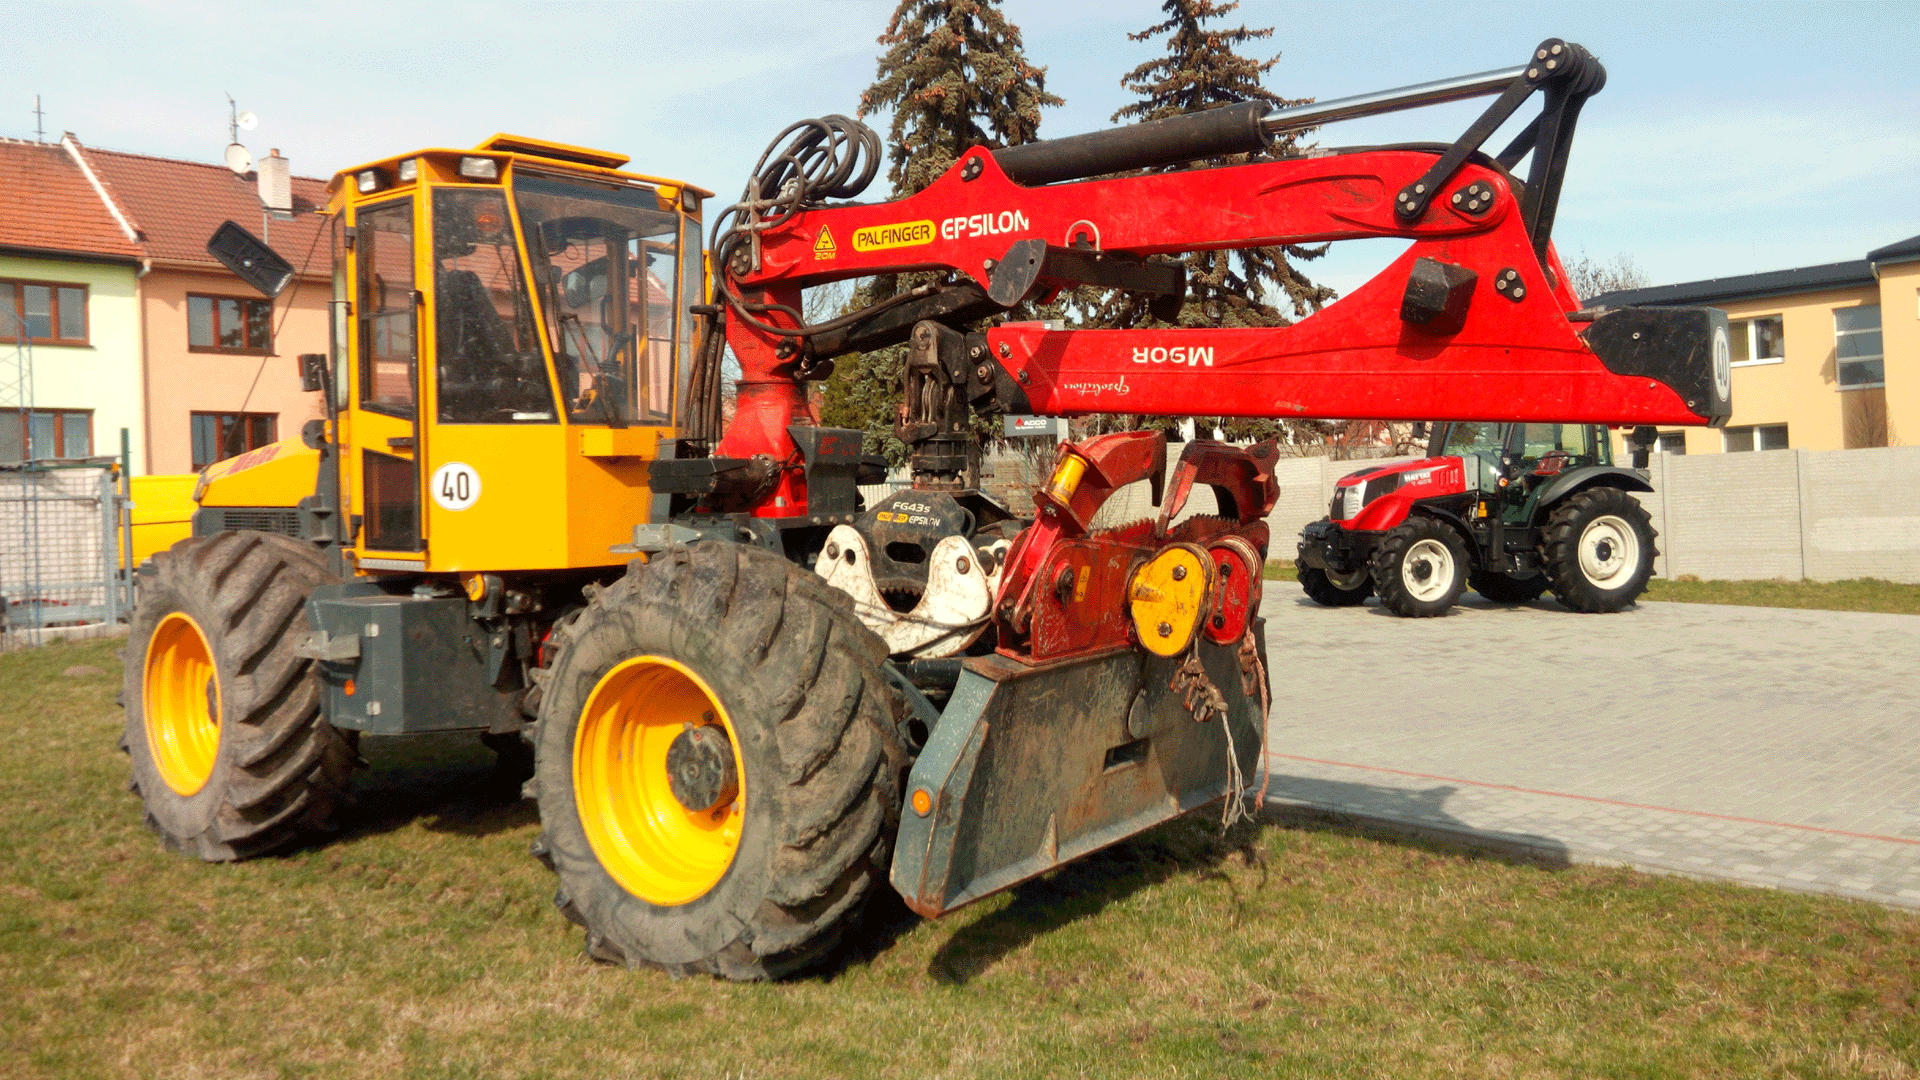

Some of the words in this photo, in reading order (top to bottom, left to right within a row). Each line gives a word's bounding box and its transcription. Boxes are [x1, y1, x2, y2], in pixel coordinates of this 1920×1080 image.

[858, 225, 930, 247] PALFINGER
[941, 210, 1029, 240] EPSILON
[1716, 340, 1728, 387] 40
[442, 471, 470, 501] 40
[892, 501, 931, 513] FG43s
